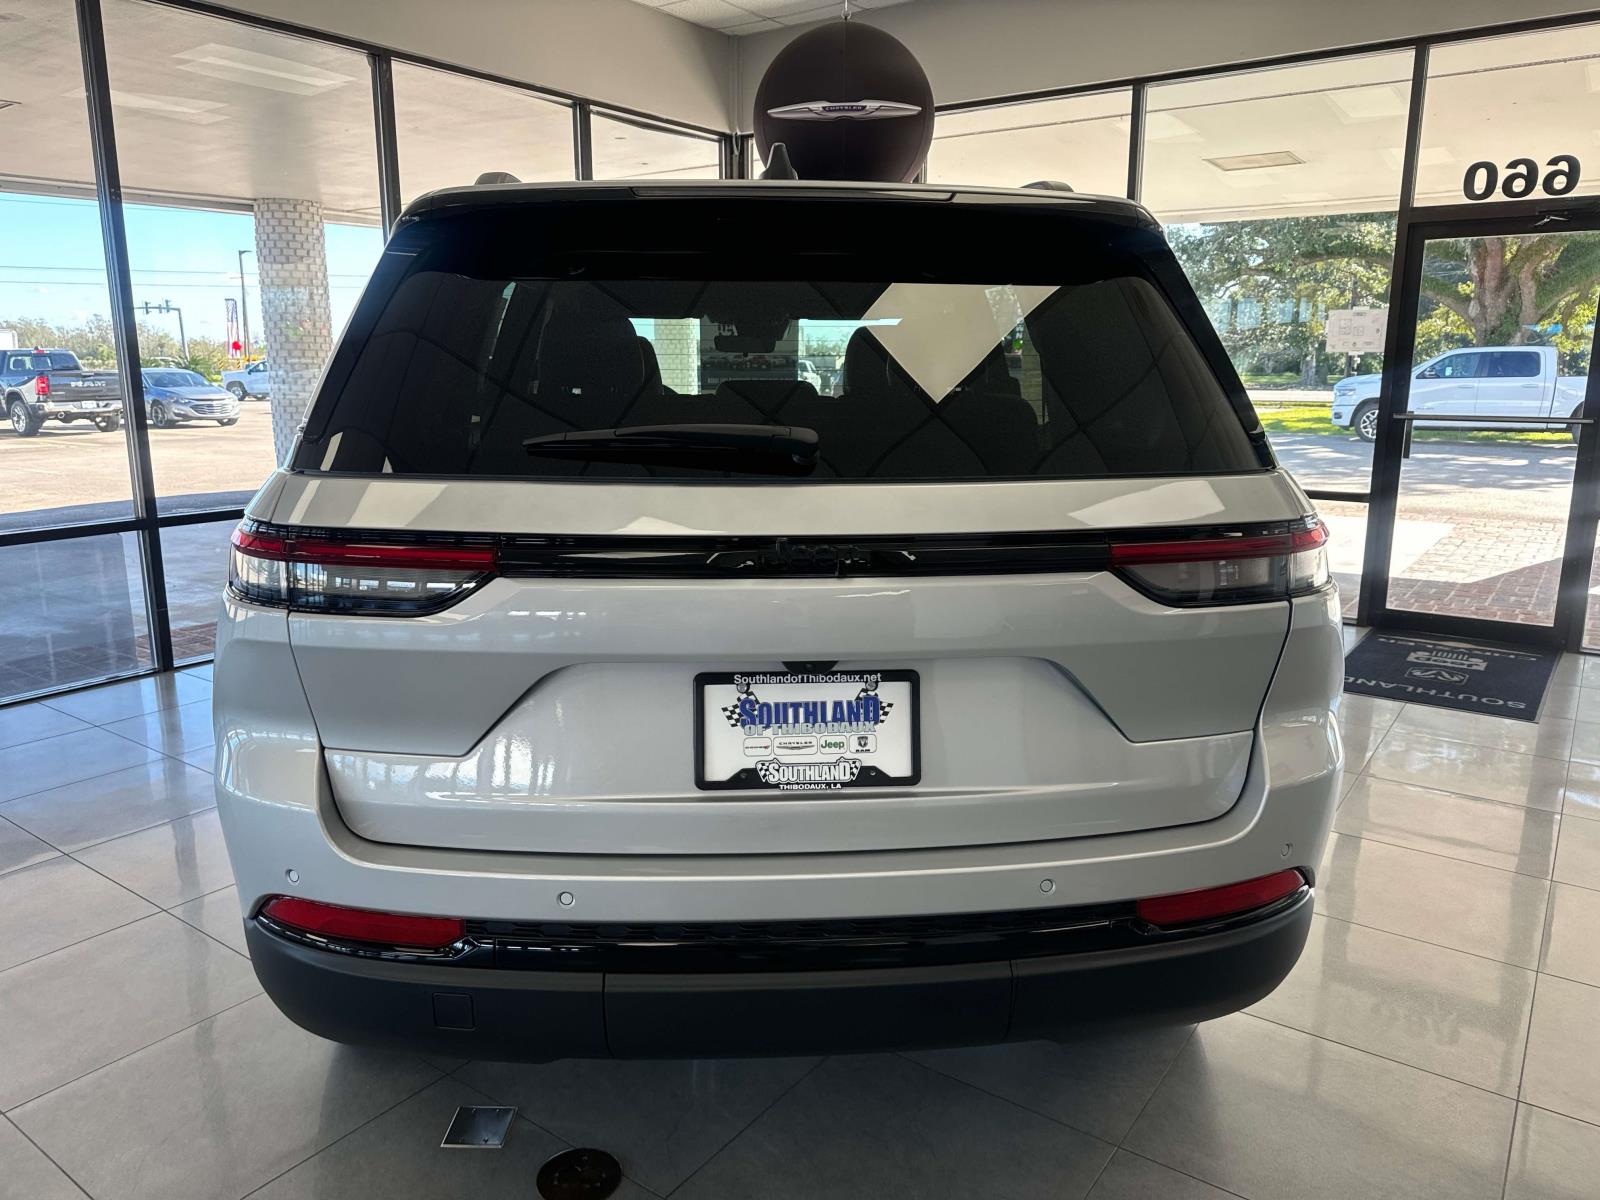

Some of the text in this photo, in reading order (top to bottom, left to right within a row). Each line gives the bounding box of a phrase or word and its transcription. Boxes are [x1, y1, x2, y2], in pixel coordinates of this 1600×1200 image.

[739, 695, 881, 728] SOUTHLAND
[743, 721, 877, 736] OF THIBODAUX
[820, 740, 845, 750] Jeep
[768, 761, 851, 783] SOUTHLAND
